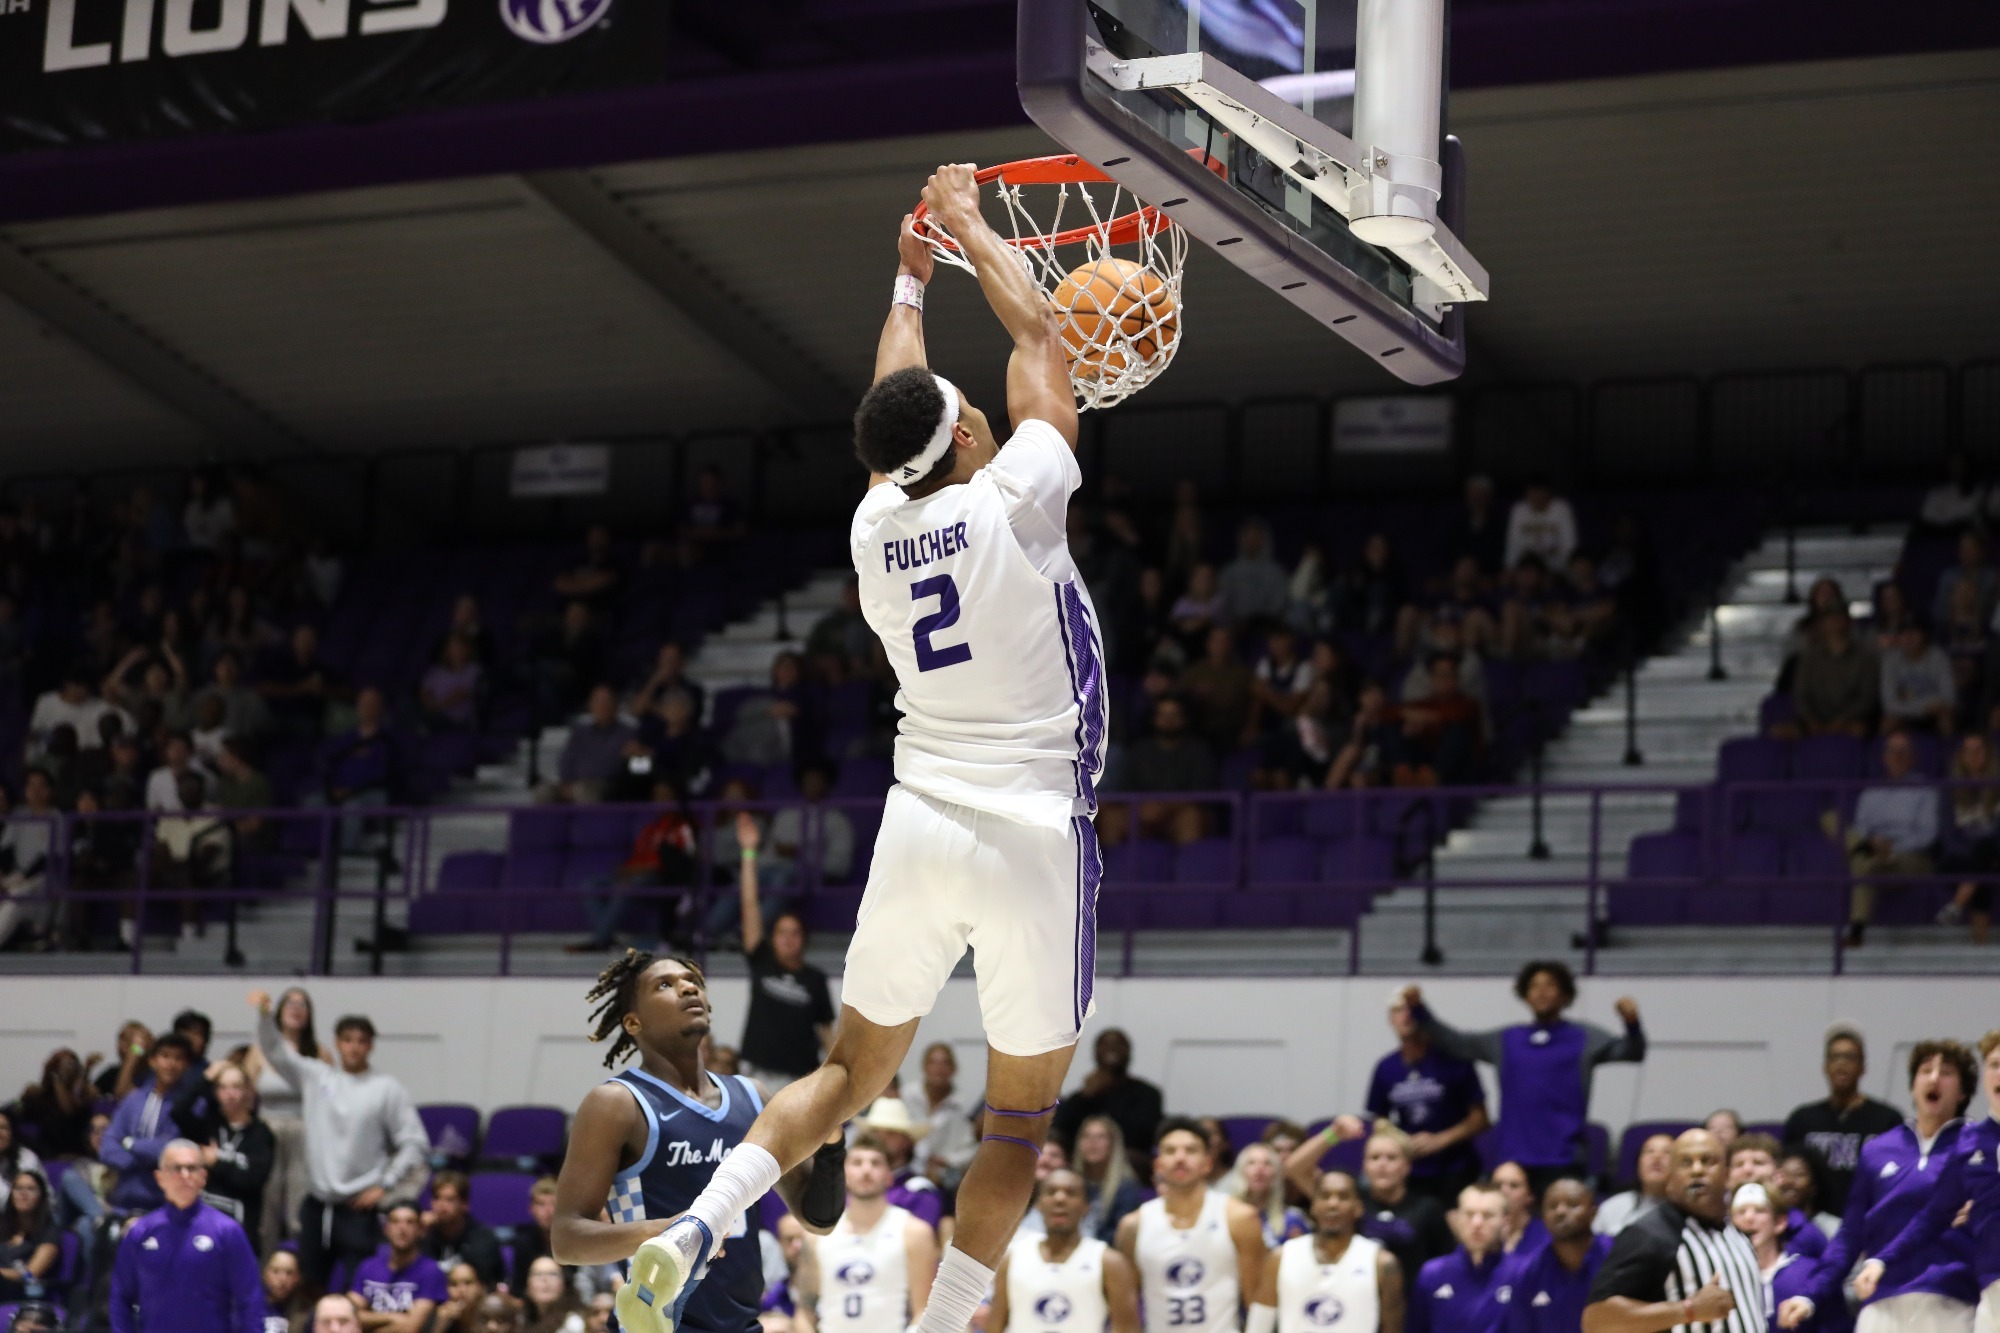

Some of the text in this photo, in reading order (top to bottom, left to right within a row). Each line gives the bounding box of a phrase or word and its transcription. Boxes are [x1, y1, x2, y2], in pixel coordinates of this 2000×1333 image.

[883, 521, 969, 573] FULCHER
[910, 573, 973, 673] 2
[666, 1140, 703, 1167] The
[1168, 1295, 1206, 1326] 33
